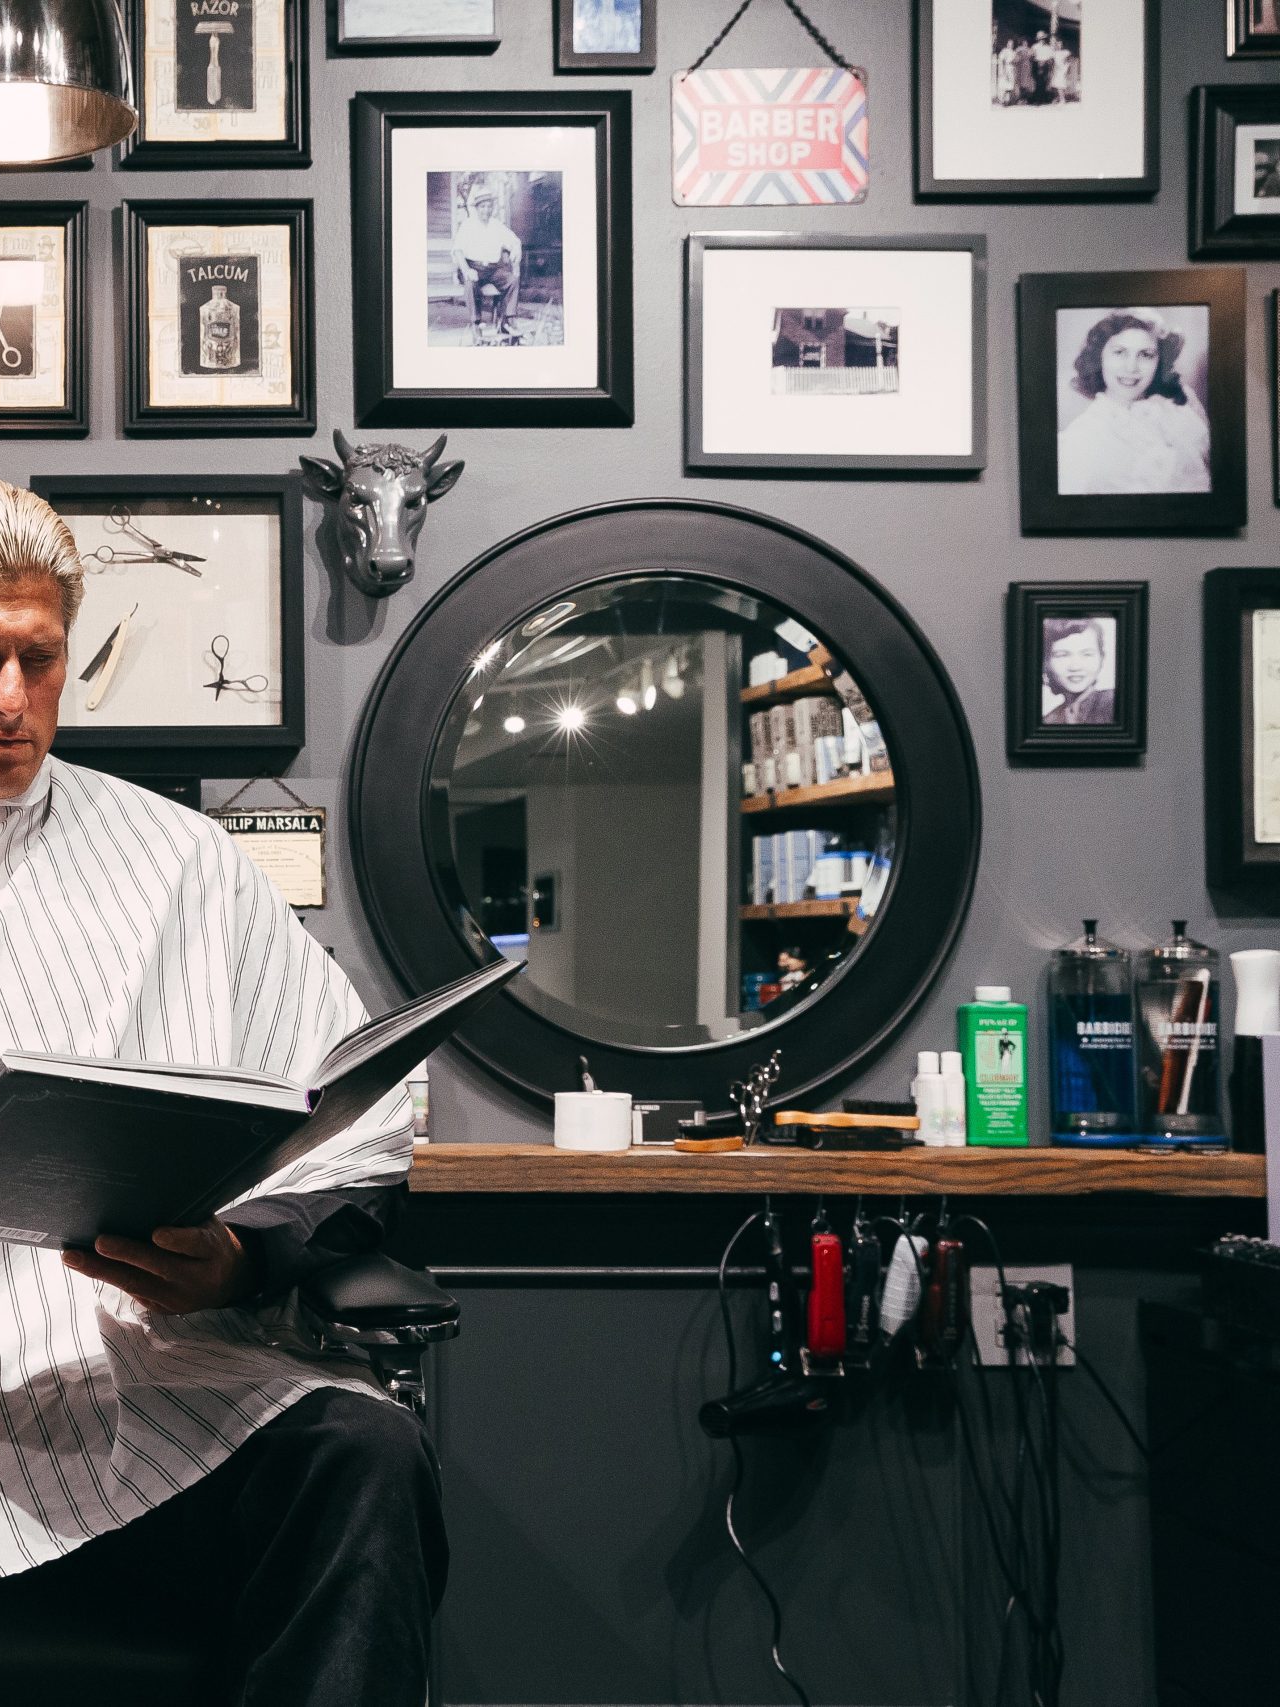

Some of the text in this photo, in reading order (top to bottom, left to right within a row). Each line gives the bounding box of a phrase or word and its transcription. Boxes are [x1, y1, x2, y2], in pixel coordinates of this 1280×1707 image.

[190, 0, 239, 17] RAZOR
[701, 107, 840, 145] BARBER
[726, 141, 812, 166] SHOP
[186, 264, 249, 282] TALCUM
[256, 817, 320, 830] MARSALA
